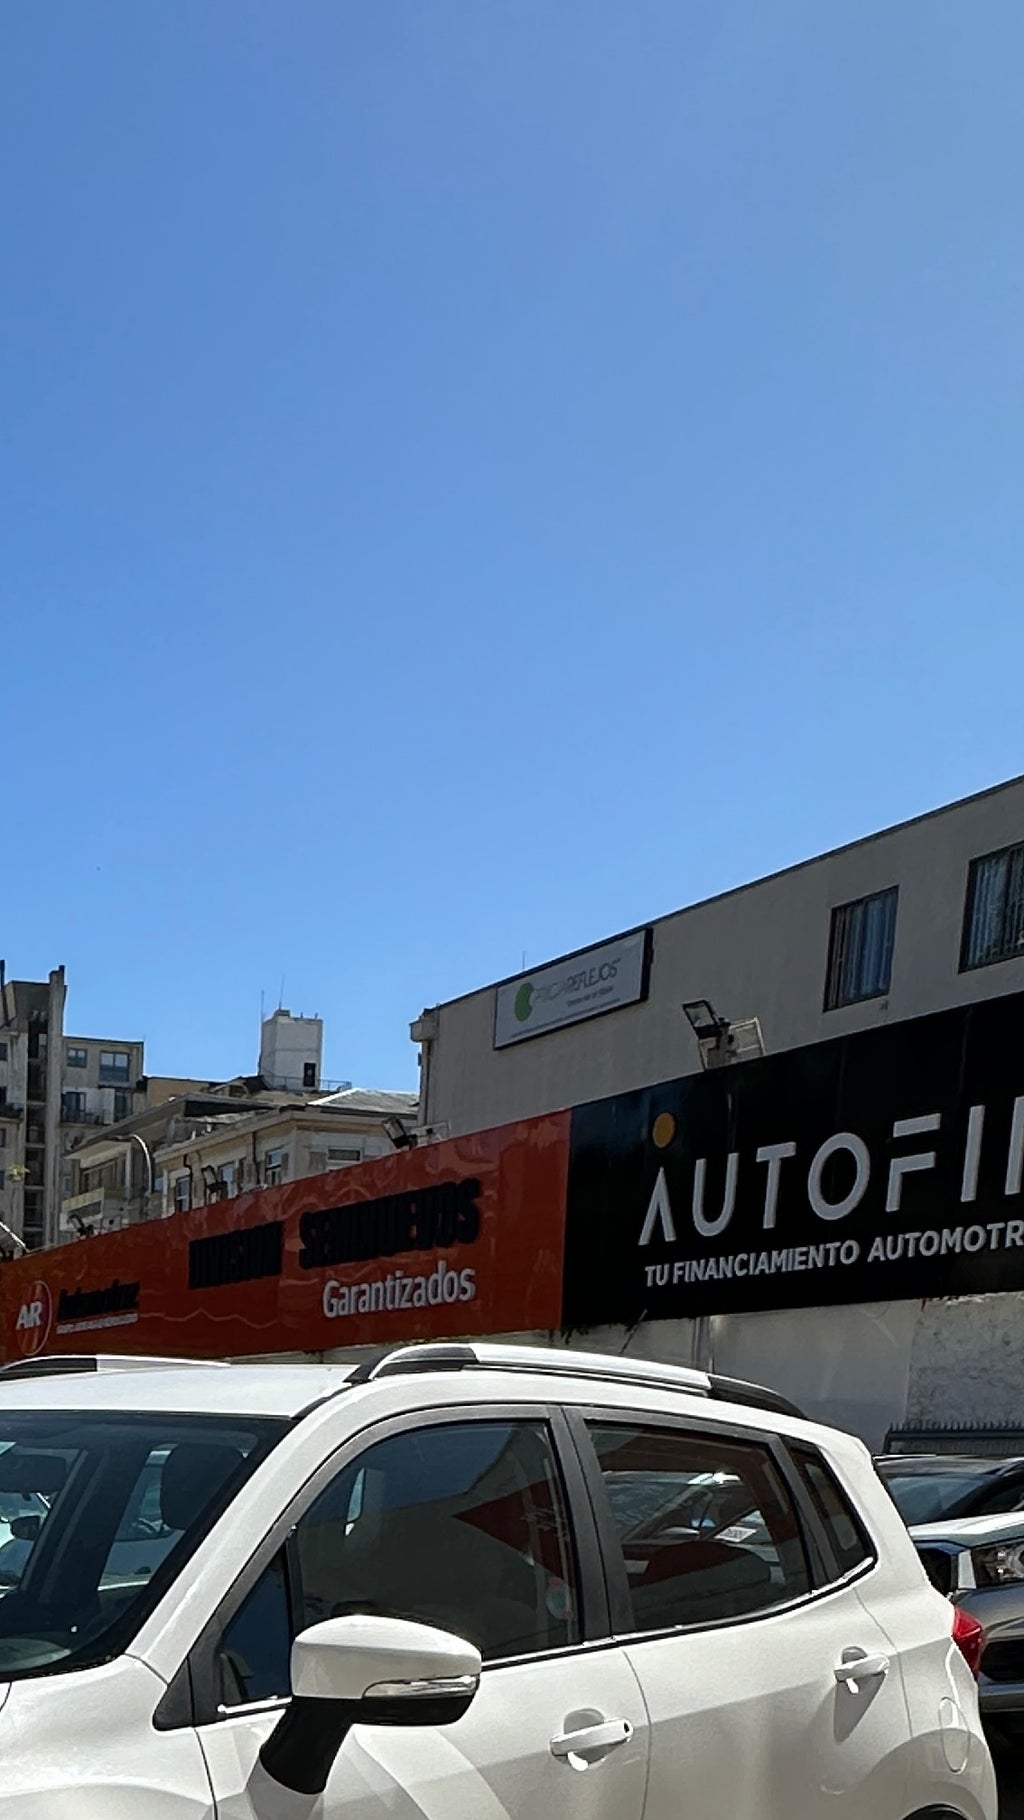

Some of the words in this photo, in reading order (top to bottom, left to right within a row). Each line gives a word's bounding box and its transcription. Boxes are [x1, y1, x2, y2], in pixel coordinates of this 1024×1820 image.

[645, 1262, 670, 1287] TU
[672, 1239, 861, 1284] FINANCIAMIENTO
[323, 1259, 476, 1318] Garantizados
[16, 1301, 42, 1331] AR
